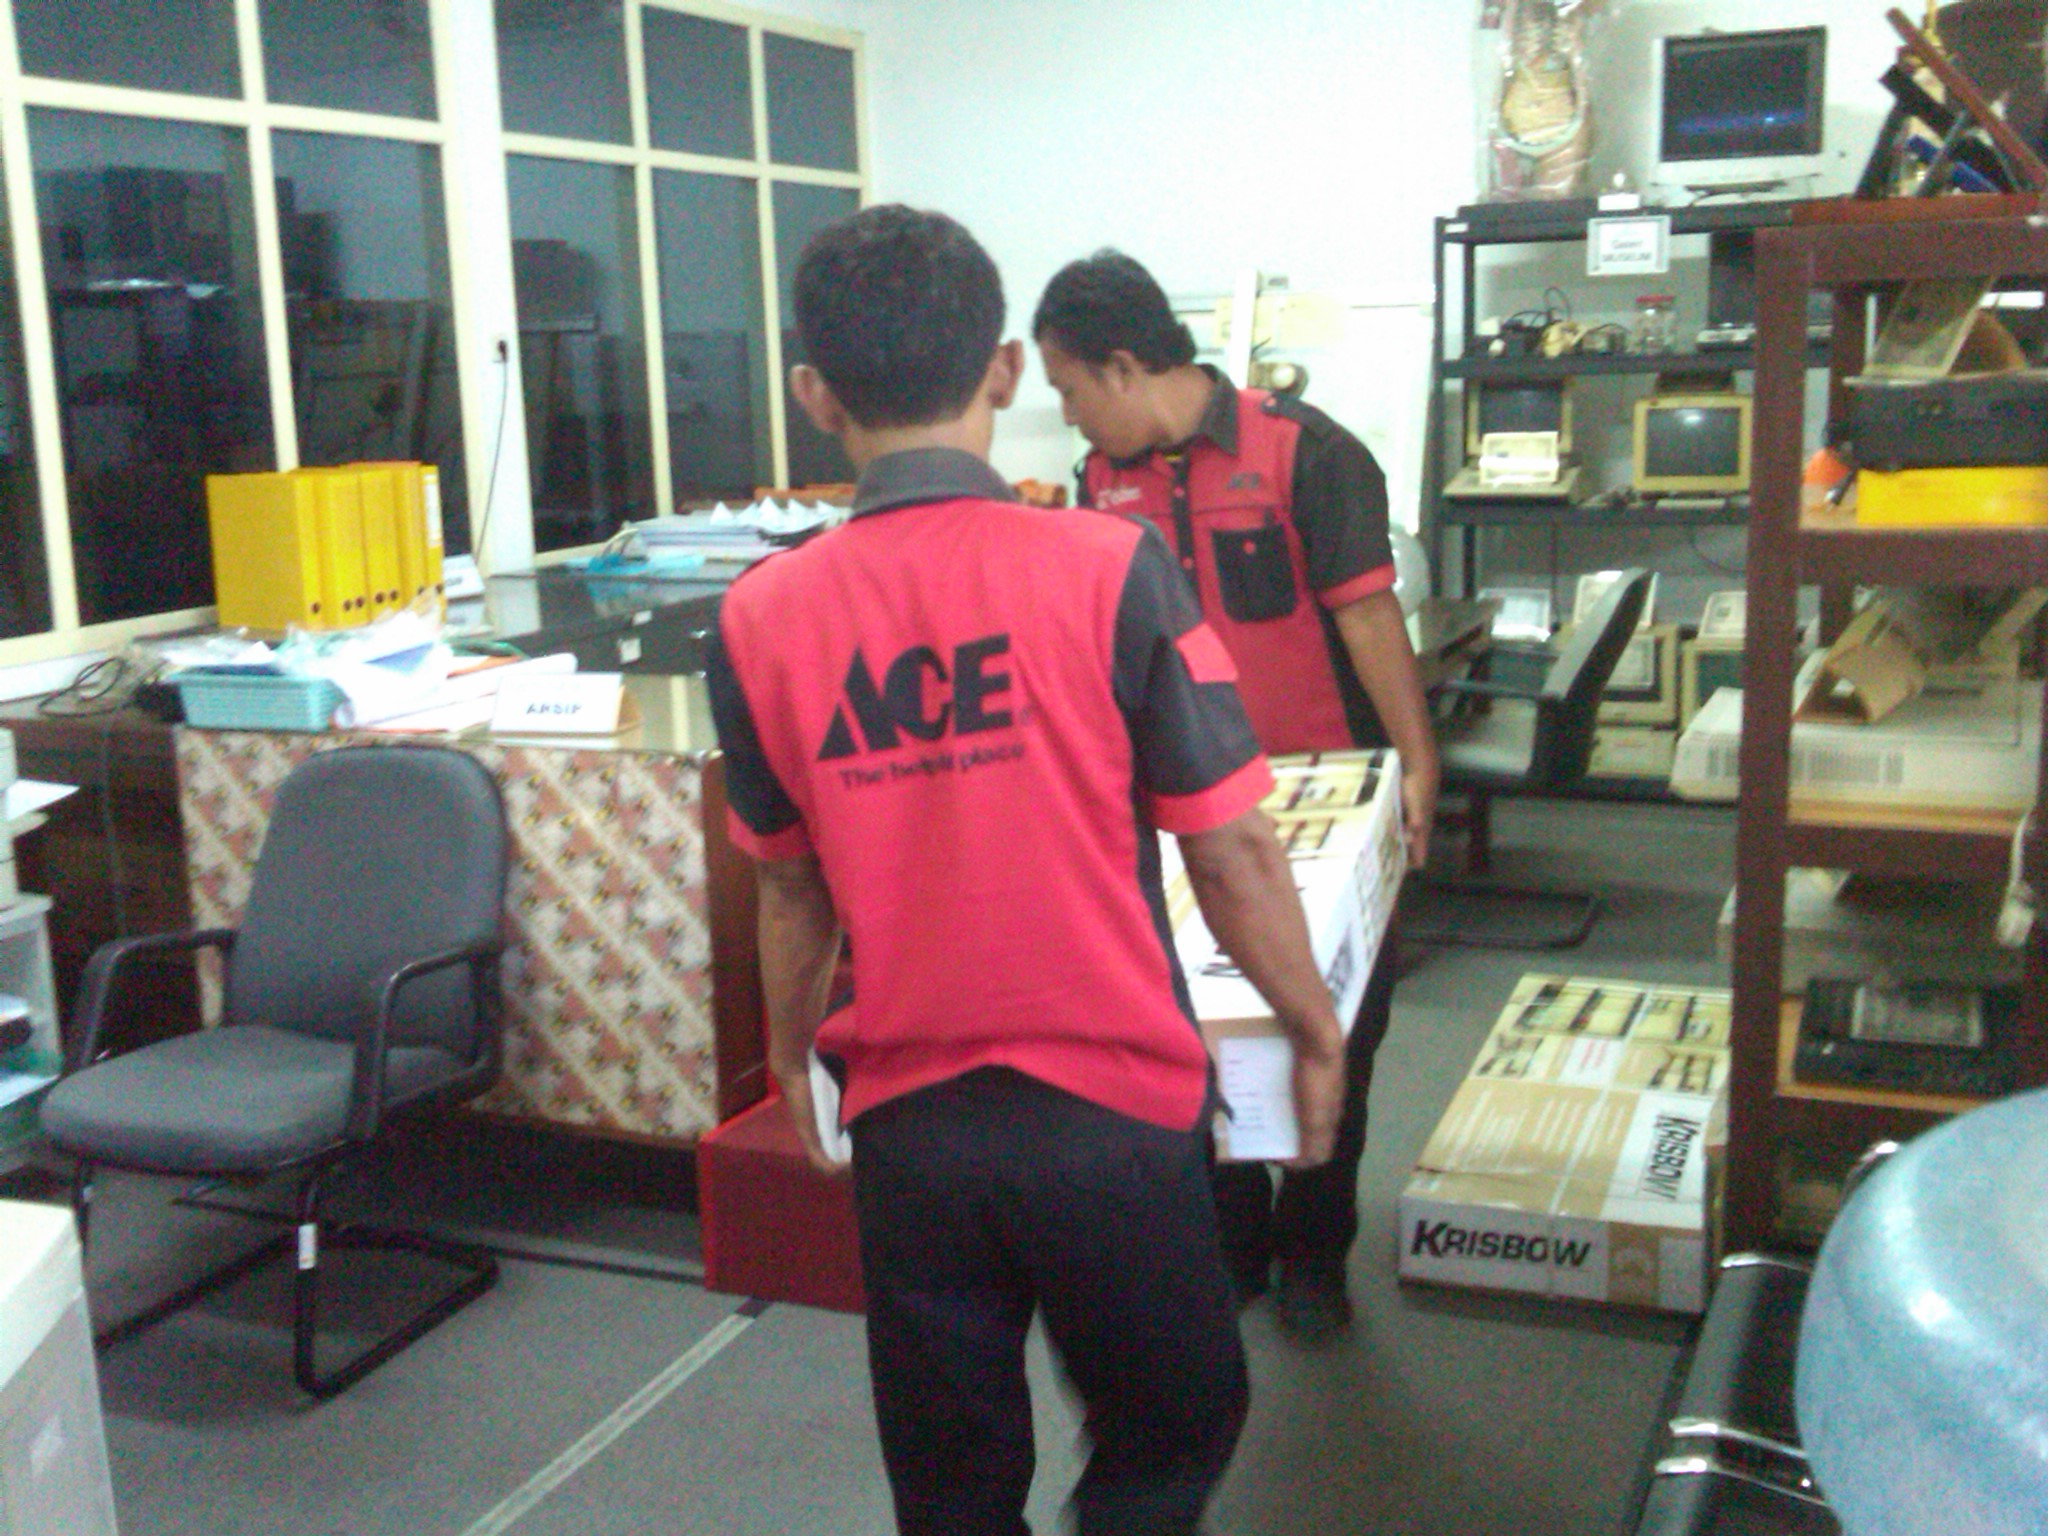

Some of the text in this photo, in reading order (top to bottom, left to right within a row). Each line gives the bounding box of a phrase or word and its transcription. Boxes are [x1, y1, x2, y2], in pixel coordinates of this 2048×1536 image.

[817, 632, 1013, 761] ACE
[1641, 1113, 1702, 1200] KRISBOW
[1411, 1220, 1591, 1268] KRISBOW
